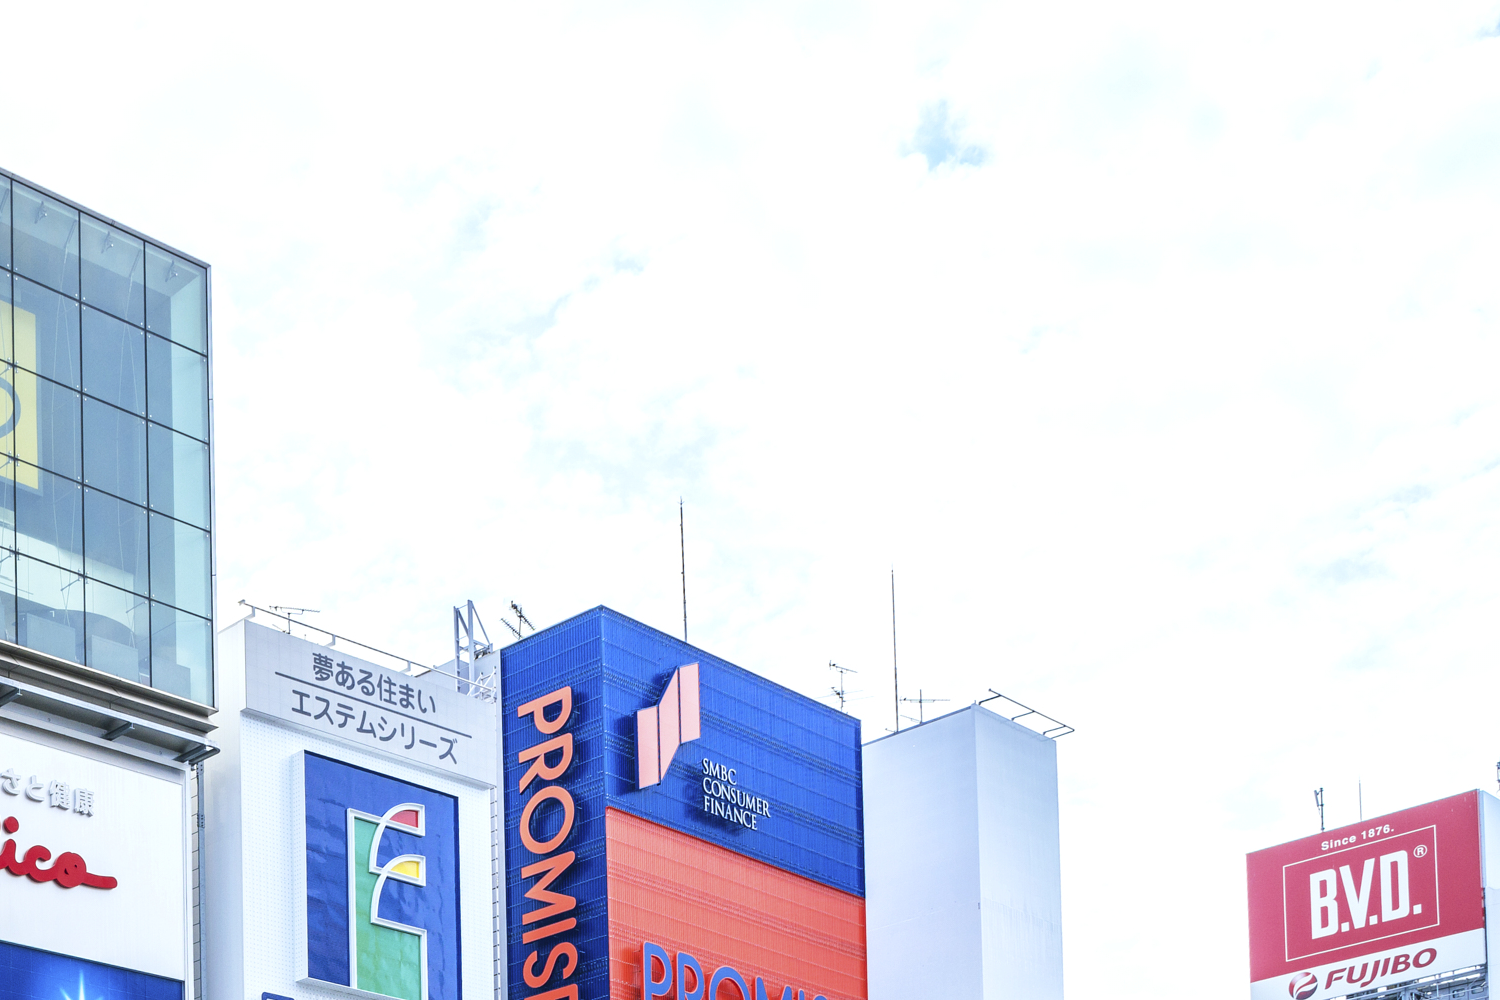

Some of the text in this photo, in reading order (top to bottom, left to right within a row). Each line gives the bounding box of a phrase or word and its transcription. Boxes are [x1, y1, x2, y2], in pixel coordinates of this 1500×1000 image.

[312, 652, 436, 714] 夢ある住まい
[291, 689, 458, 765] エステムシリーズ
[702, 757, 737, 786] SMBC
[702, 777, 771, 818] CONSUMER
[703, 795, 758, 831] FINANCE
[1321, 823, 1394, 851] Since 1876.
[1309, 850, 1422, 940] B.V.D.
[1324, 947, 1437, 990] FUJIBO
